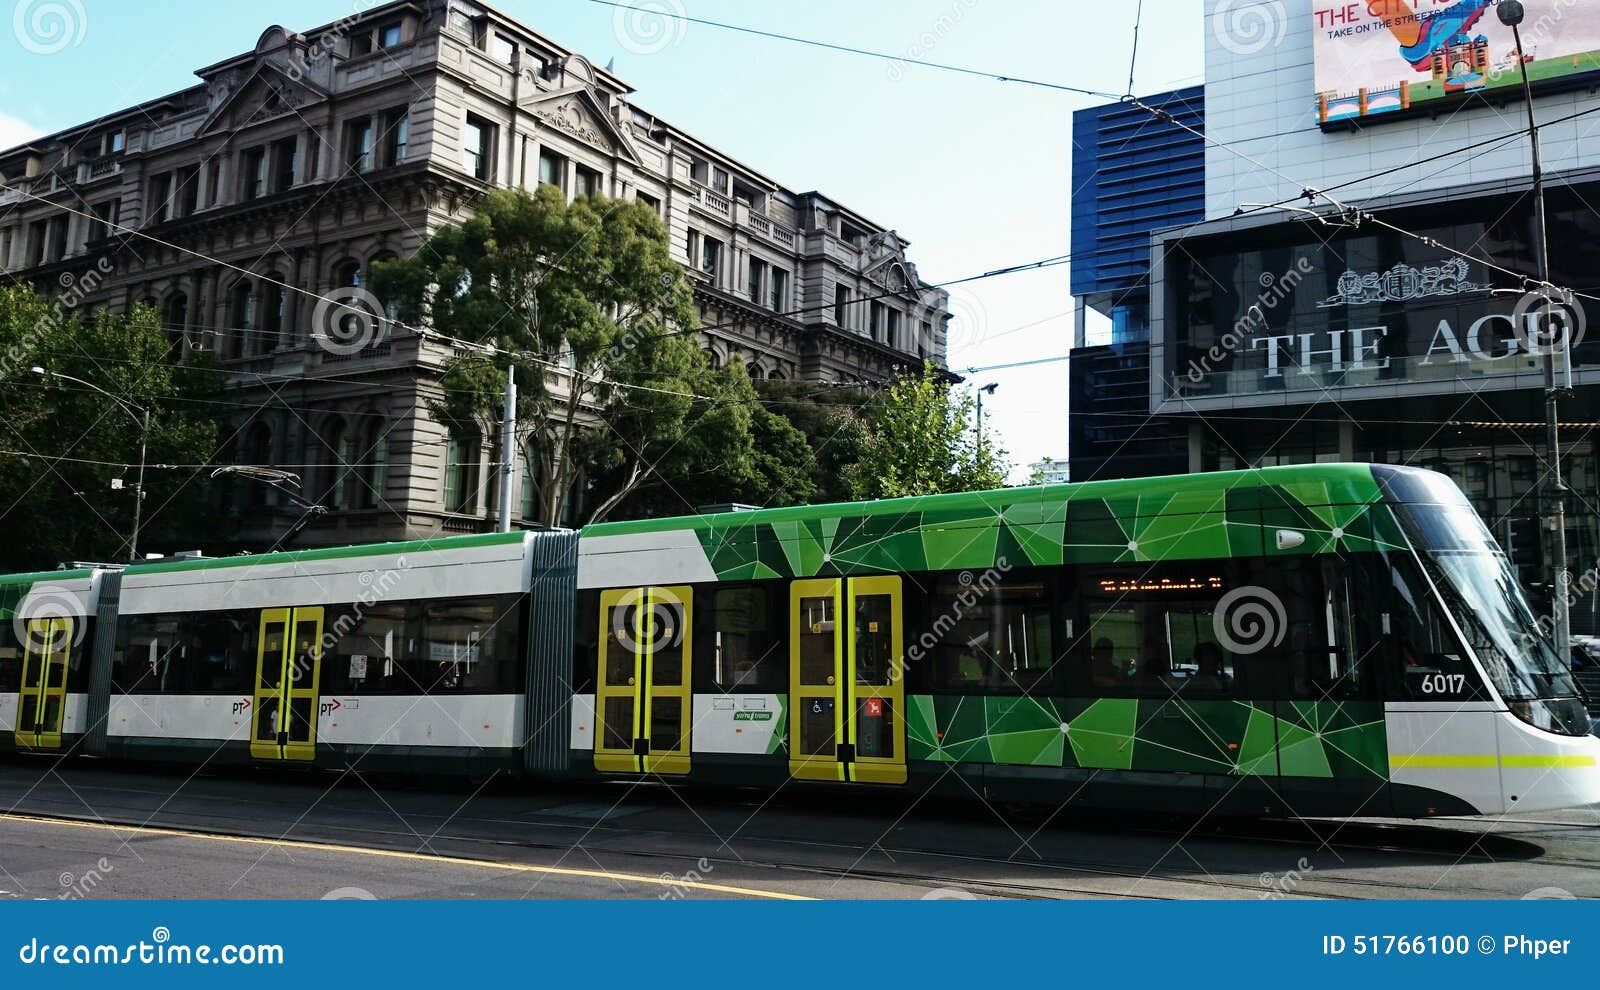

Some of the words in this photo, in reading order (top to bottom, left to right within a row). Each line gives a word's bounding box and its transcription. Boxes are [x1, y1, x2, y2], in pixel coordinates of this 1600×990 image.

[1314, 3, 1360, 29] THE
[1328, 27, 1353, 39] TAKE
[1355, 24, 1371, 34] ON
[1373, 19, 1392, 31] THE
[1252, 325, 1390, 378] THE
[1417, 308, 1567, 366] AGE
[1421, 674, 1465, 694] 6017
